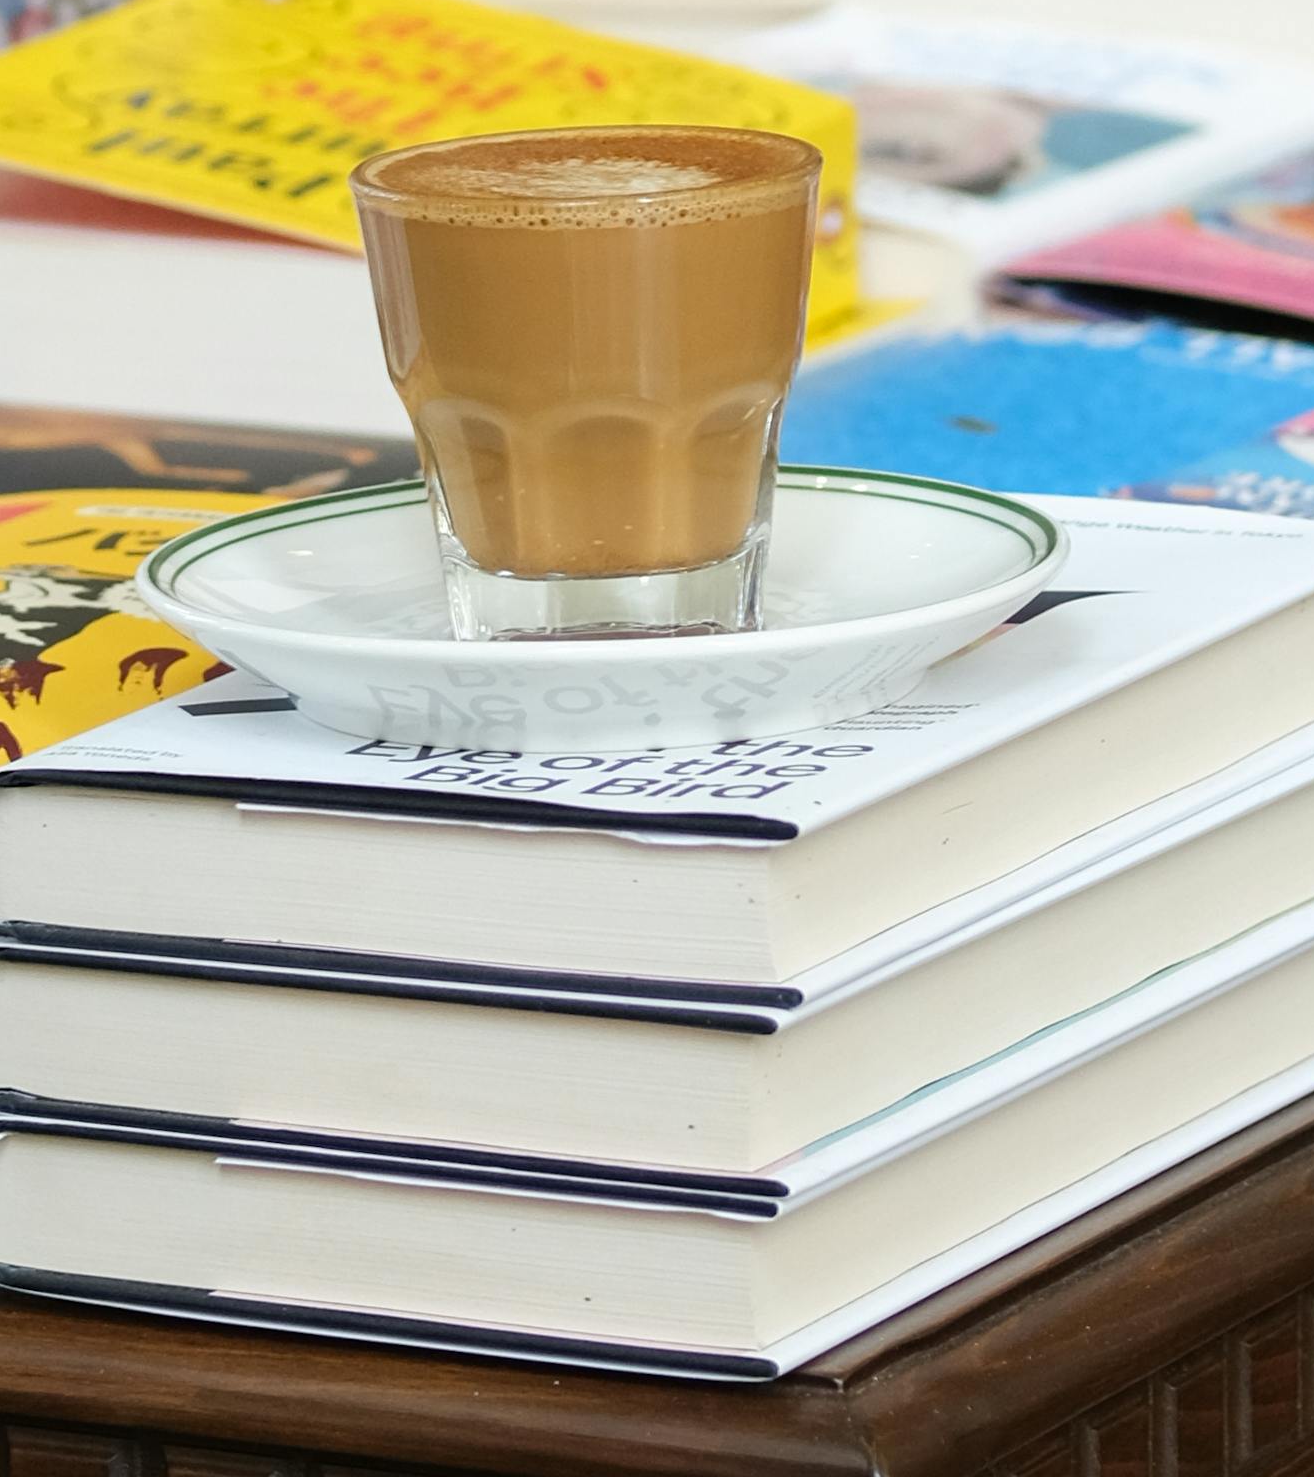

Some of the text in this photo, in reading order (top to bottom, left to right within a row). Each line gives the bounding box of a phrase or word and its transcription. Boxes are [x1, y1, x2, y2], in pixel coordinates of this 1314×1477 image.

[344, 739, 829, 778] Eye of the
[710, 739, 876, 758] the
[402, 765, 795, 799] Big Bird
